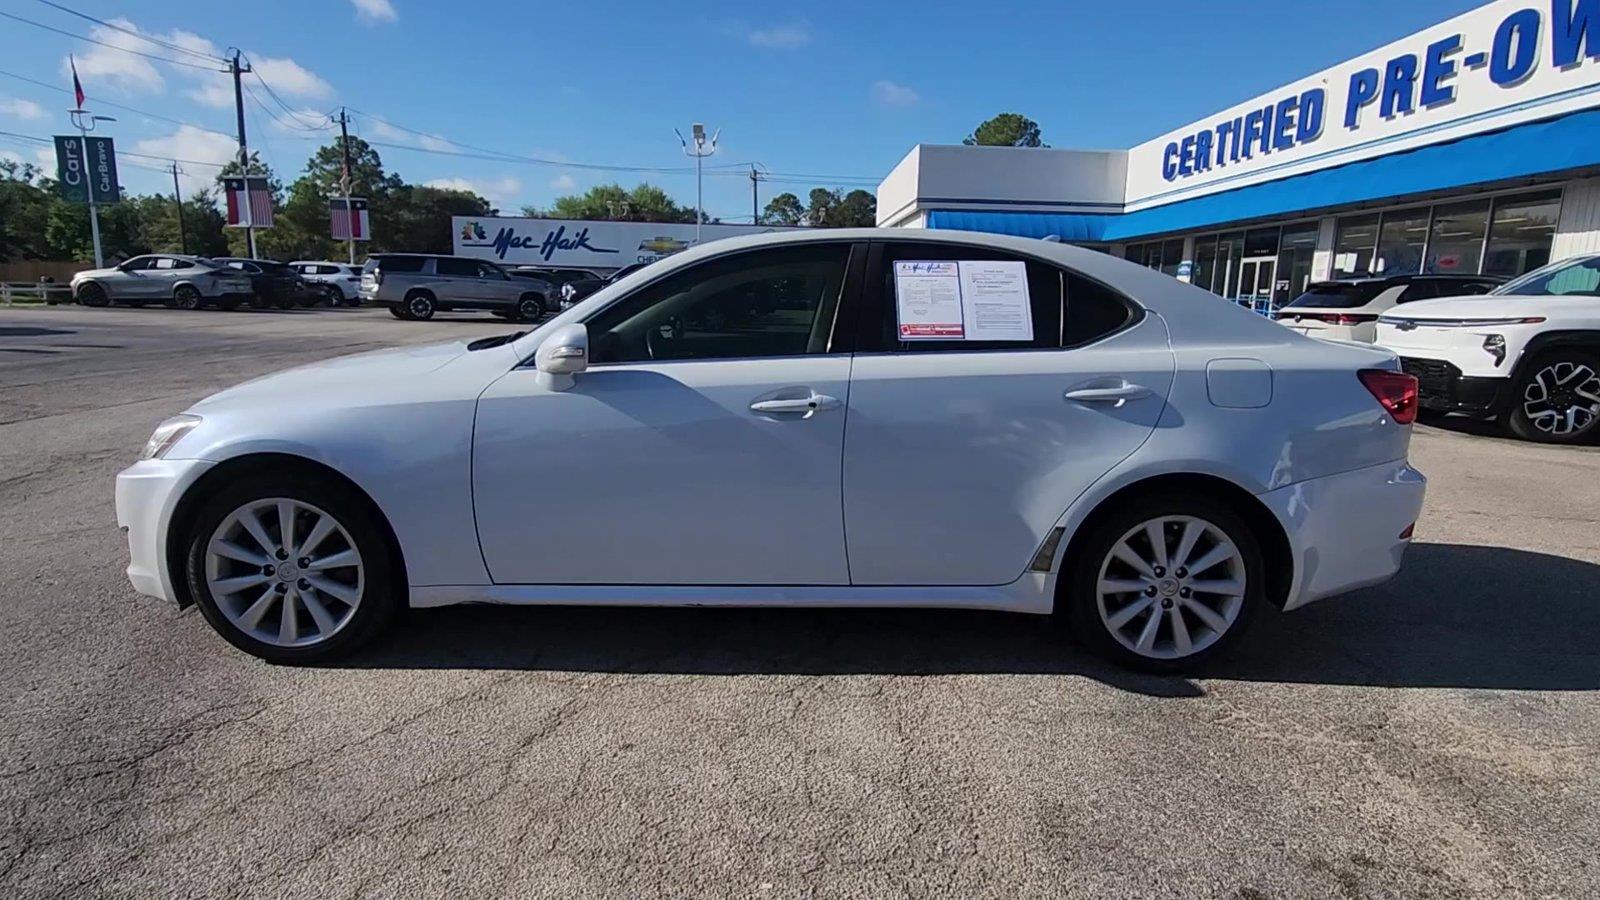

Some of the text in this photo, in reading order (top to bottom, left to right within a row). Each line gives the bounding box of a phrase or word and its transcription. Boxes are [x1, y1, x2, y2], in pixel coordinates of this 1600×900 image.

[1162, 88, 1327, 182] CERTIFIED
[64, 139, 80, 186] Cars
[97, 140, 110, 192] CarBravo
[491, 225, 619, 261] Mac Haik
